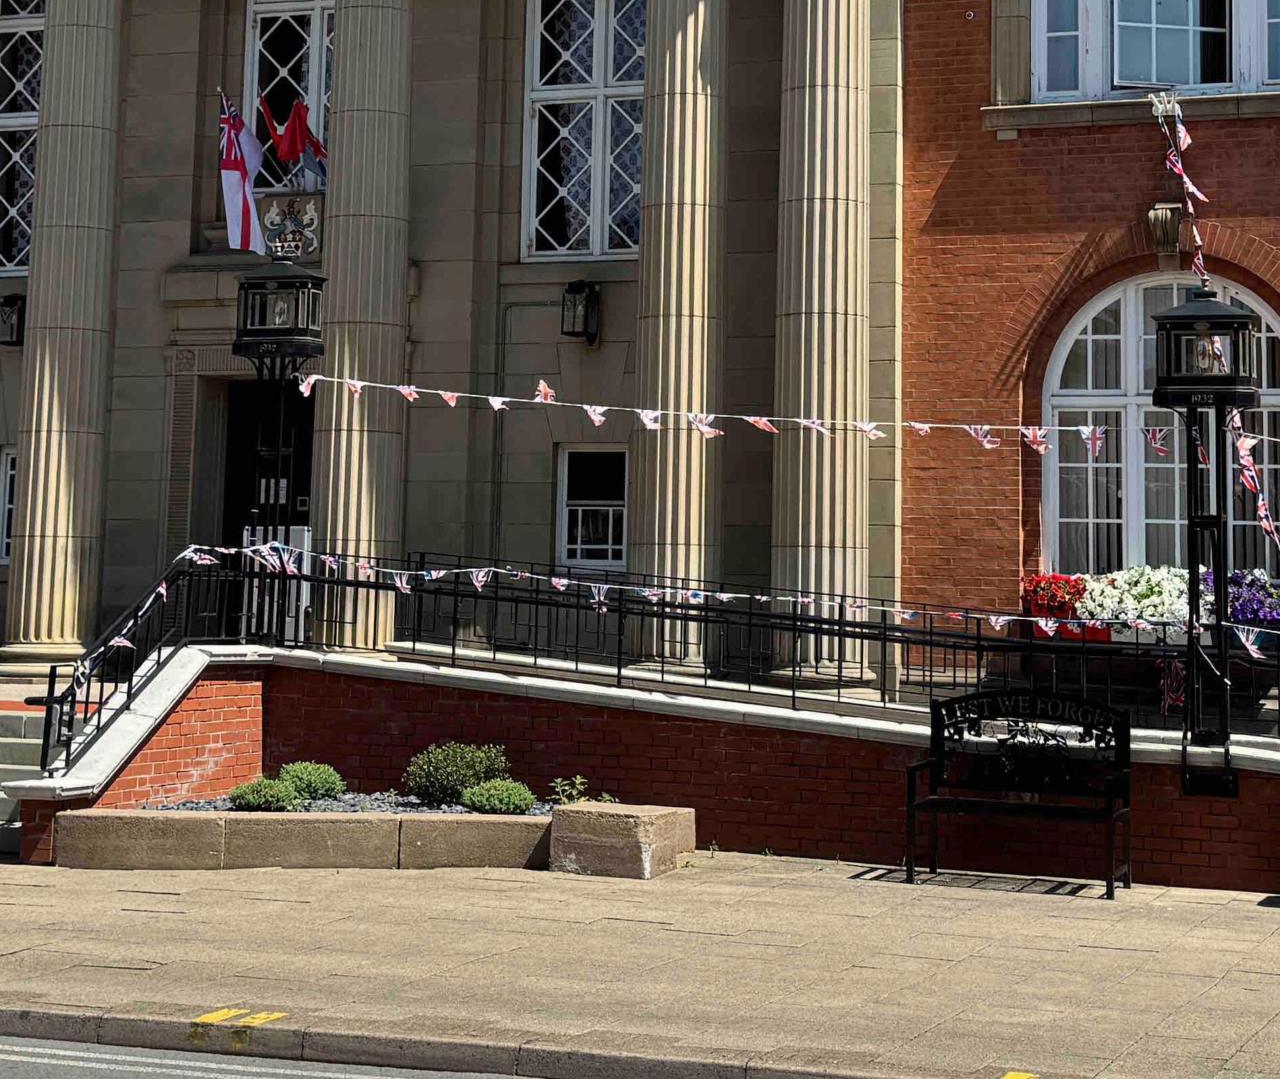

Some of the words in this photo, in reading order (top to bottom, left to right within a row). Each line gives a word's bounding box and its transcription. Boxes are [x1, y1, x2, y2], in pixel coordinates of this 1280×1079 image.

[1191, 394, 1214, 404] 1932
[942, 699, 992, 724] LEST
[997, 696, 1030, 714] WE
[1036, 697, 1120, 725] FORGET
